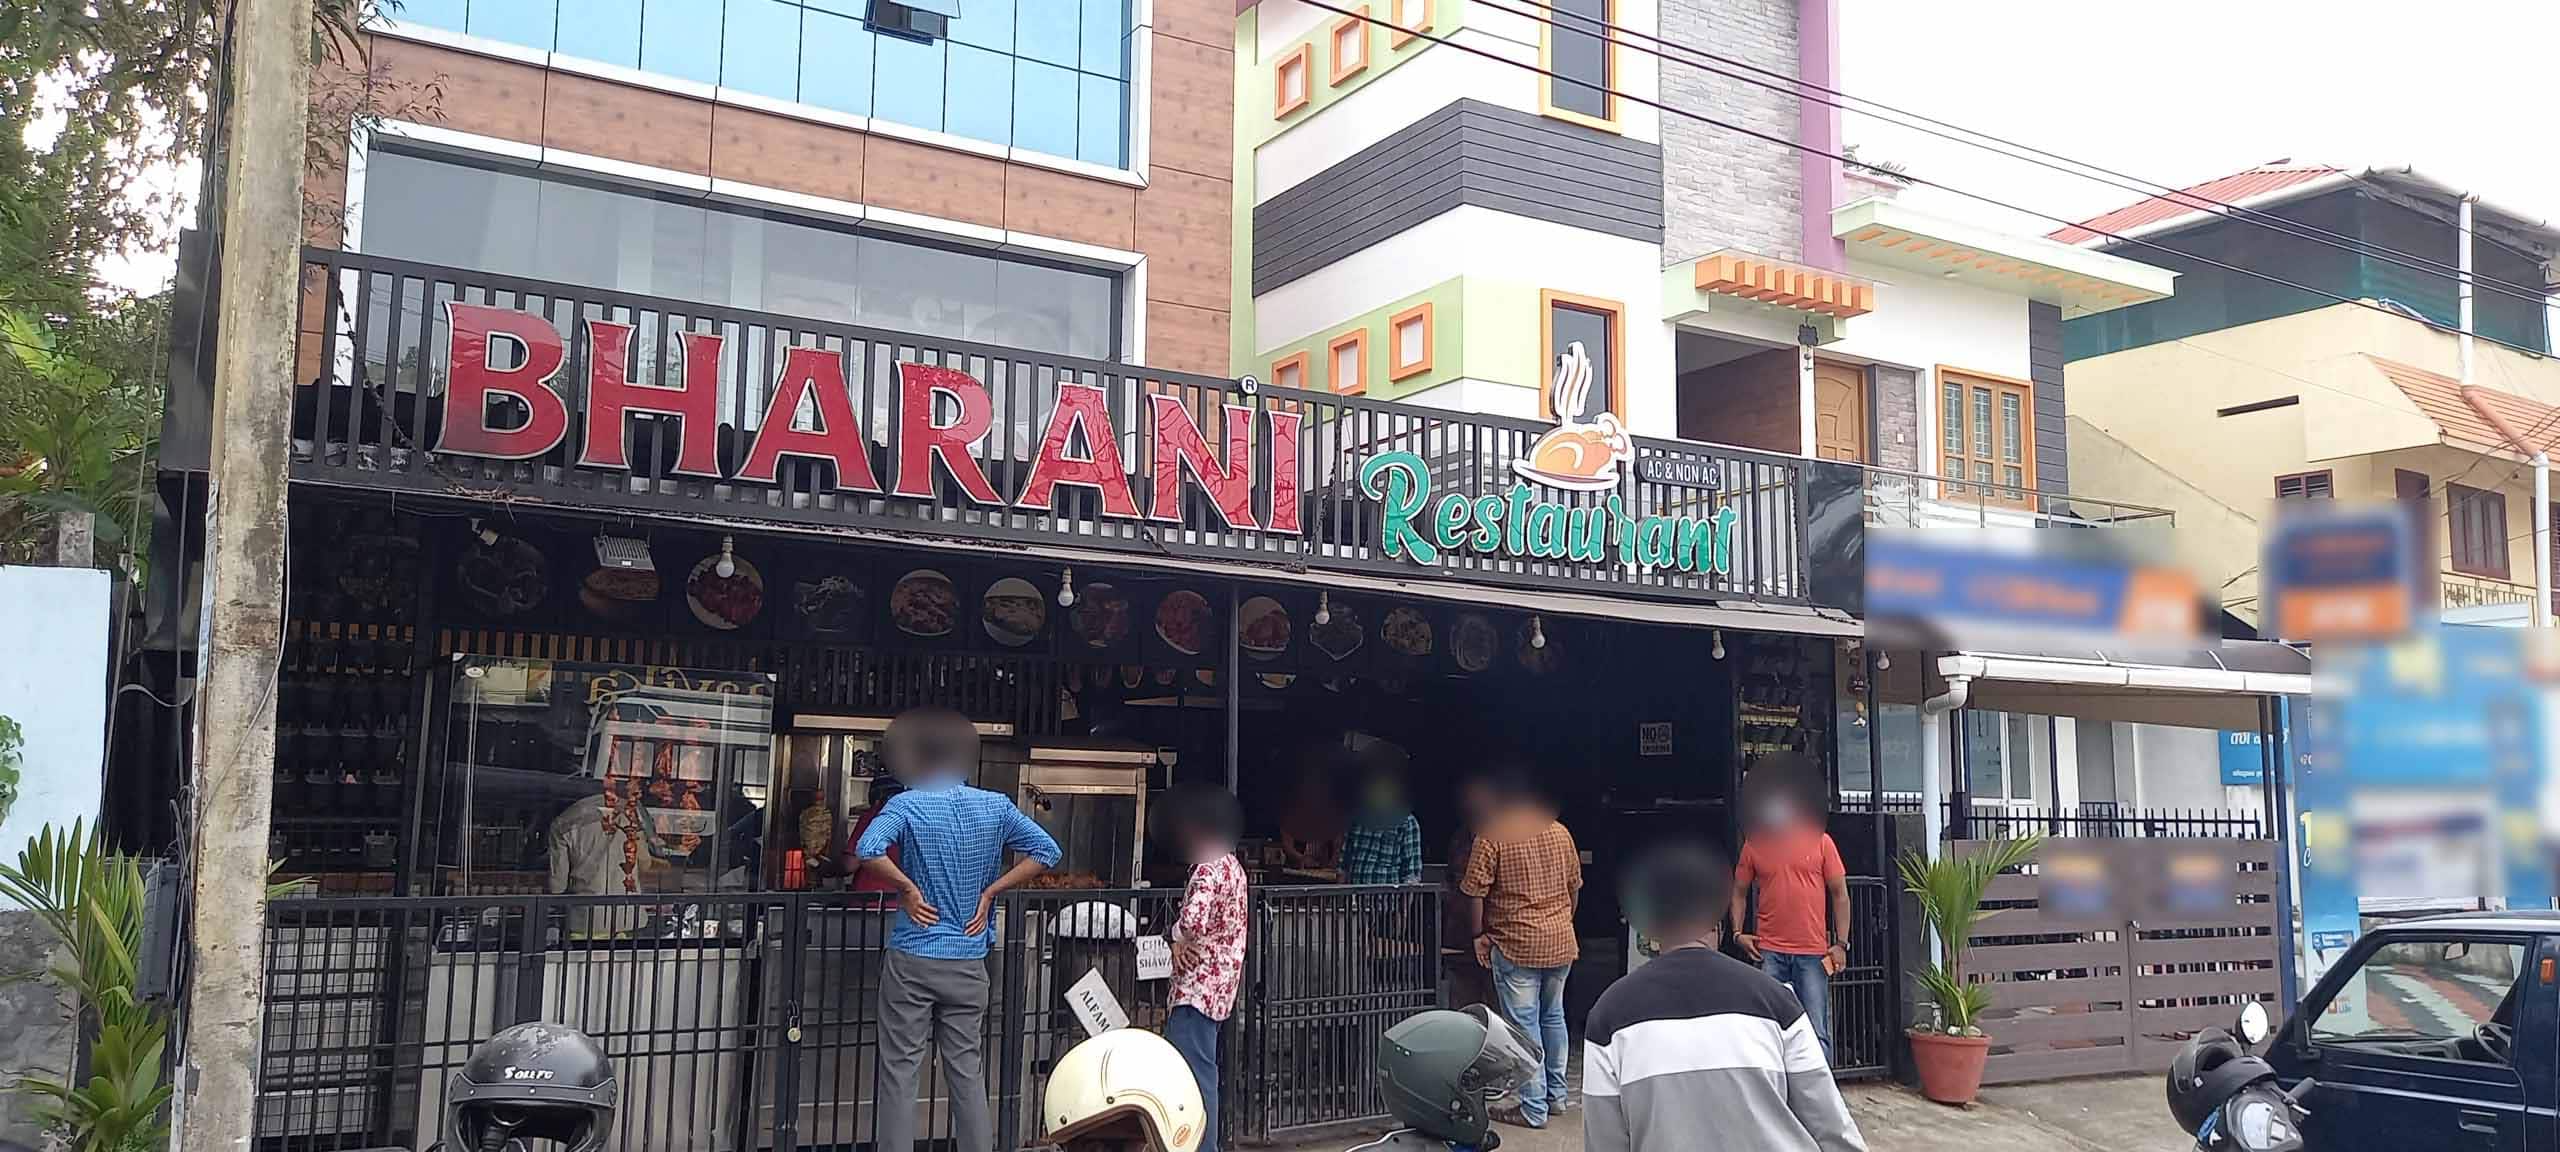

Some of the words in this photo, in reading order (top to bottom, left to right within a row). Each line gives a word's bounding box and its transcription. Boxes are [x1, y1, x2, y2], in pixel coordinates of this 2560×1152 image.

[434, 300, 1305, 537] BHARANI
[1647, 460, 1662, 479] AC
[1664, 462, 1673, 480] &
[1676, 463, 1699, 483] NON
[1702, 467, 1717, 485] AC
[1360, 450, 1738, 575] Restaurant
[1142, 939, 1169, 951] CHIC
